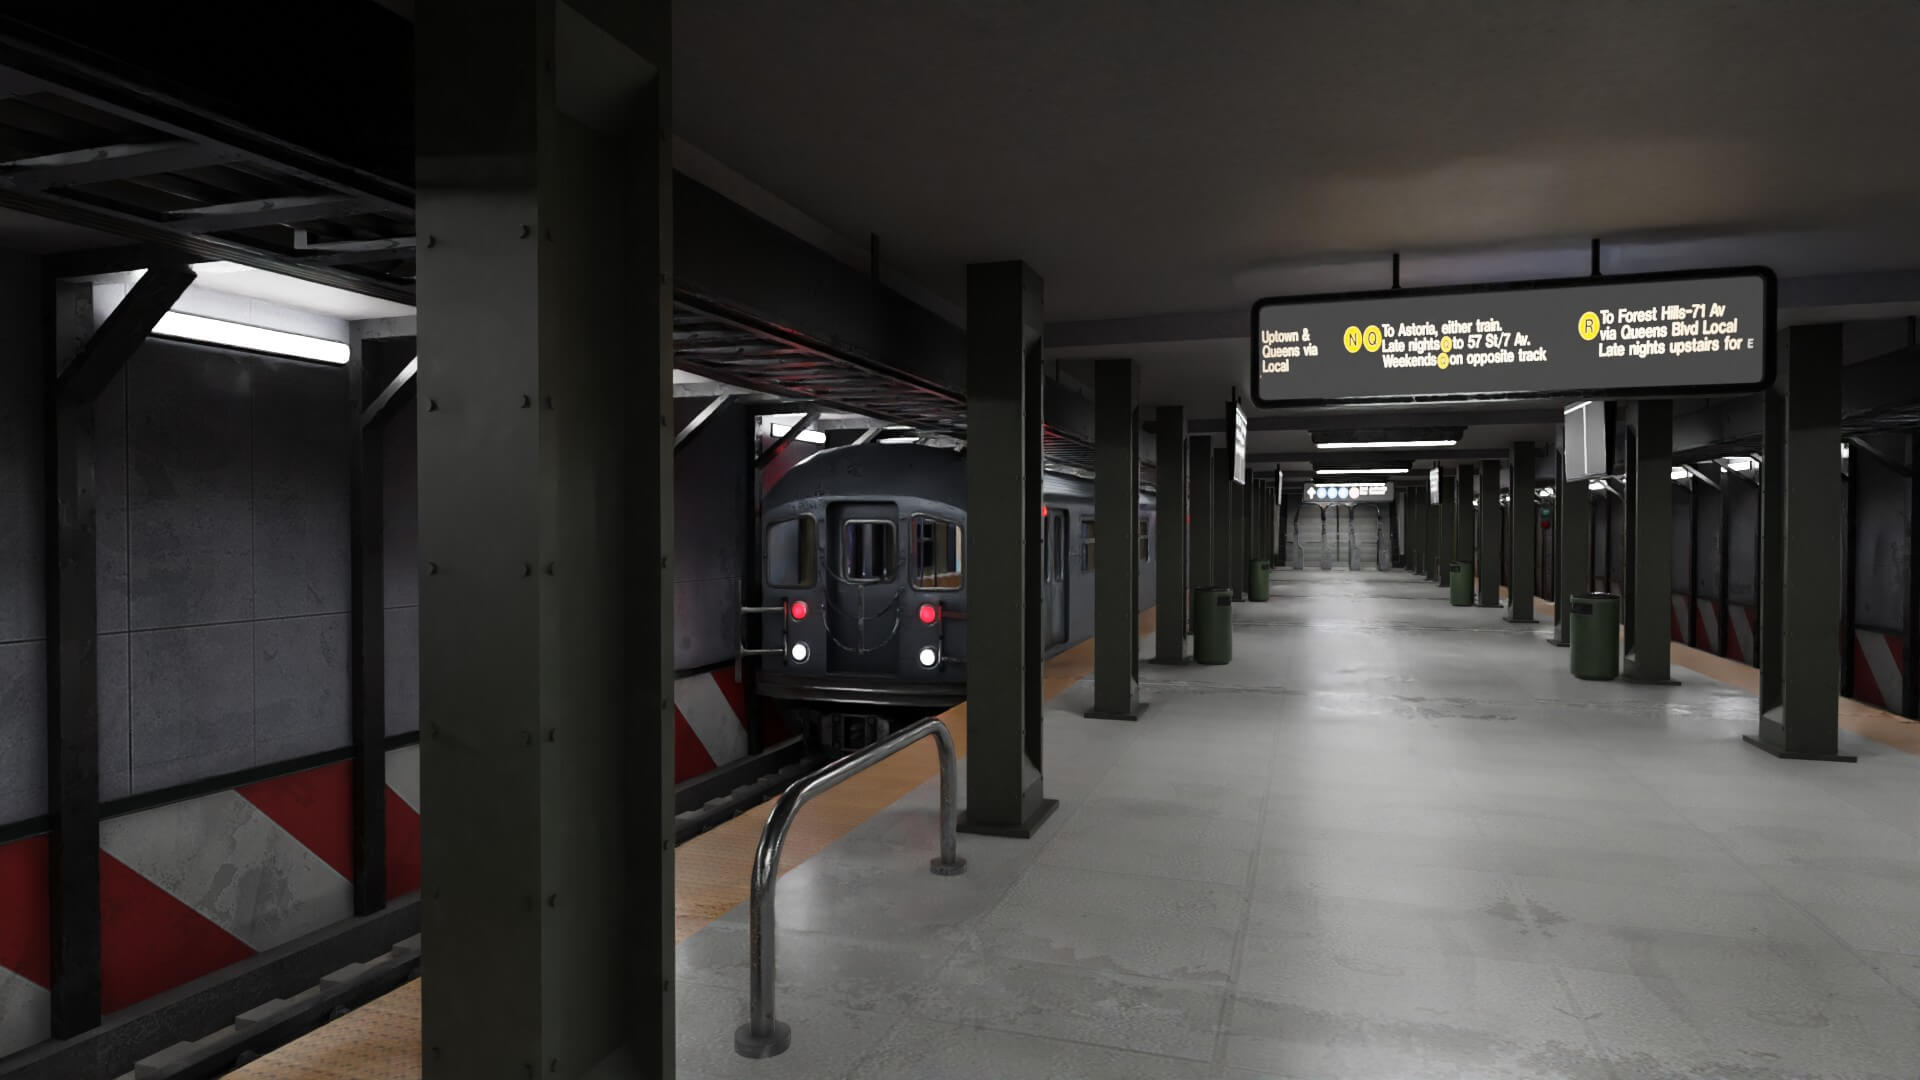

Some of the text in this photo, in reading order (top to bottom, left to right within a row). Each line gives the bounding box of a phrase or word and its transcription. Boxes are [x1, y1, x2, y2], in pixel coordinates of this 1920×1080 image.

[1600, 303, 1726, 324] To Forest Hills-71 Av
[1262, 328, 1310, 345] Uptown &
[1382, 318, 1503, 337] To Astoria, either train.
[1600, 318, 1738, 340] via Queens Blvd Local
[1262, 343, 1318, 358] Queens via
[1382, 339, 1405, 352] Late
[1408, 337, 1441, 353] nights
[1452, 336, 1465, 349] to
[1467, 334, 1483, 348] 57
[1485, 332, 1511, 348] St/7
[1514, 332, 1531, 346] Av.
[1599, 336, 1754, 358] Late nights upstairs for E
[1262, 359, 1290, 373] Local
[1382, 353, 1437, 368] Weekends
[1449, 354, 1464, 365] on
[1466, 349, 1514, 367] opposite
[1518, 347, 1547, 361] track
